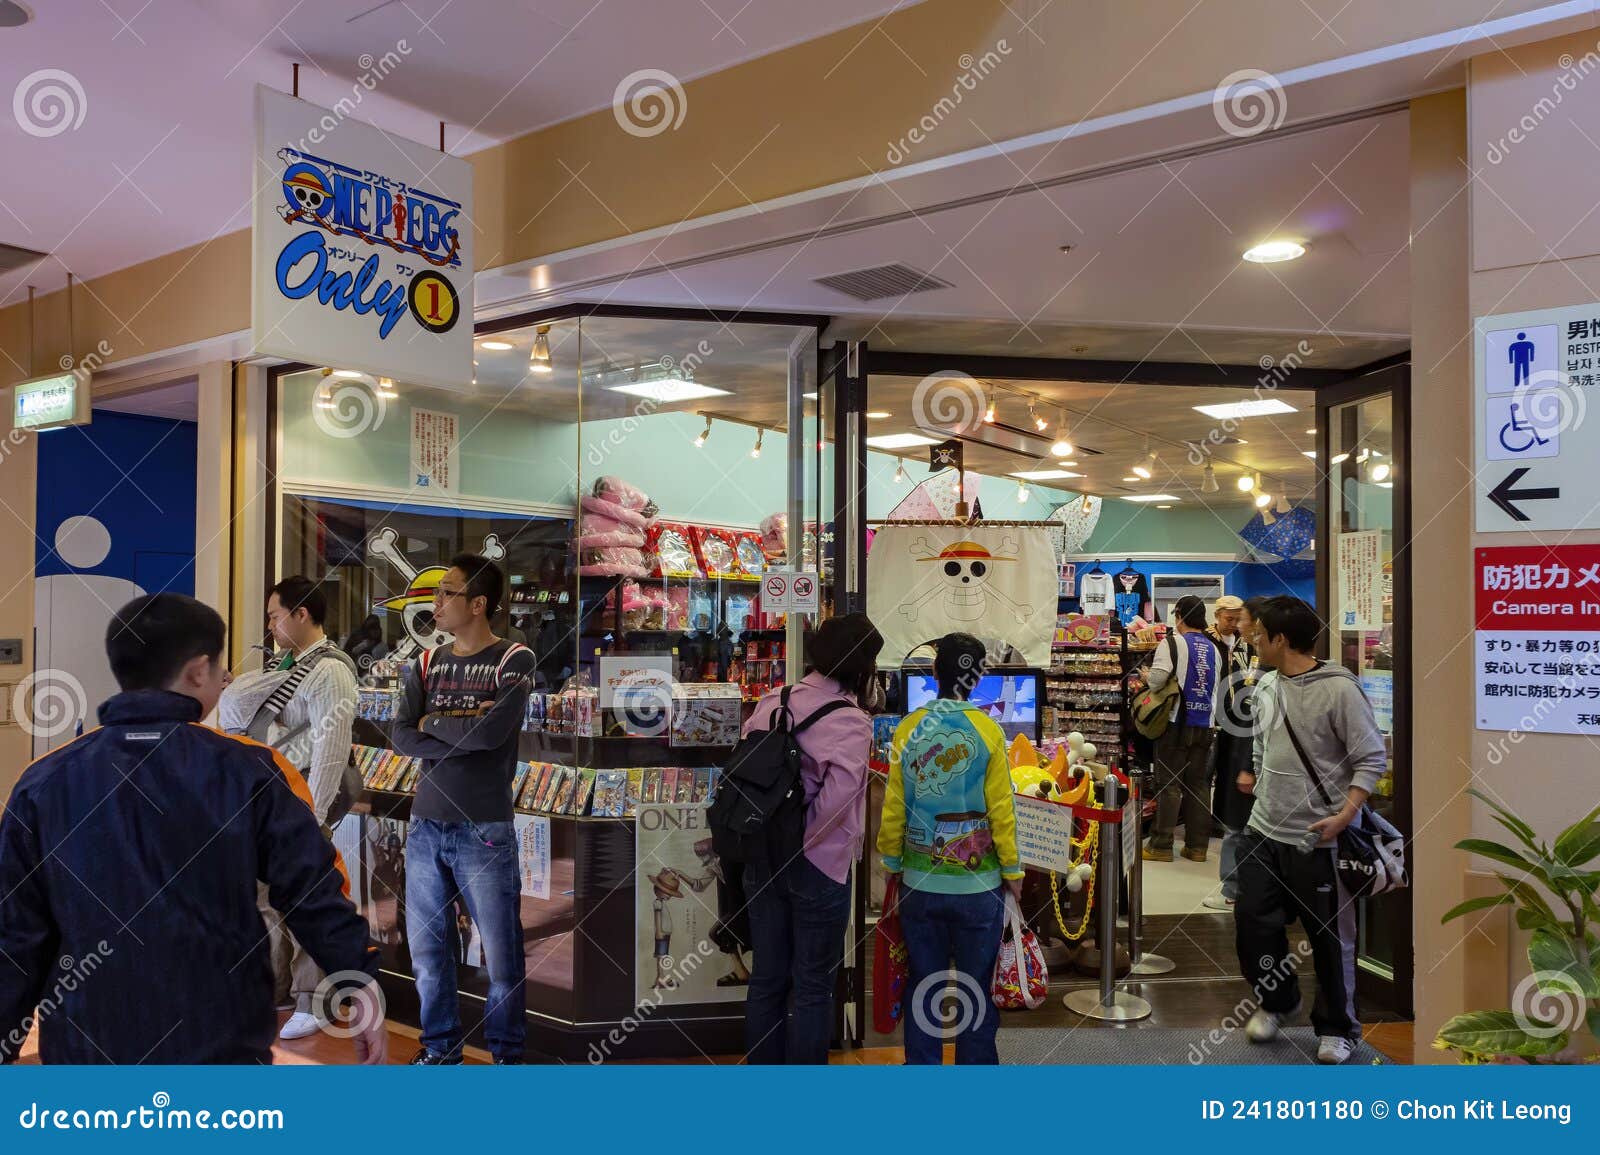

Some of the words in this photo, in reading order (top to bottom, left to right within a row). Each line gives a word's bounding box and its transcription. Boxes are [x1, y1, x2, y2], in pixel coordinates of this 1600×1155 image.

[363, 170, 408, 195] ワンピース
[327, 246, 366, 262] オンリー
[395, 263, 415, 277] ワン
[275, 230, 408, 340] Only
[1567, 358, 1592, 371] 남자
[1483, 563, 1600, 591] 防犯カメ
[1492, 600, 1574, 616] Camera
[639, 807, 699, 831] ONE
